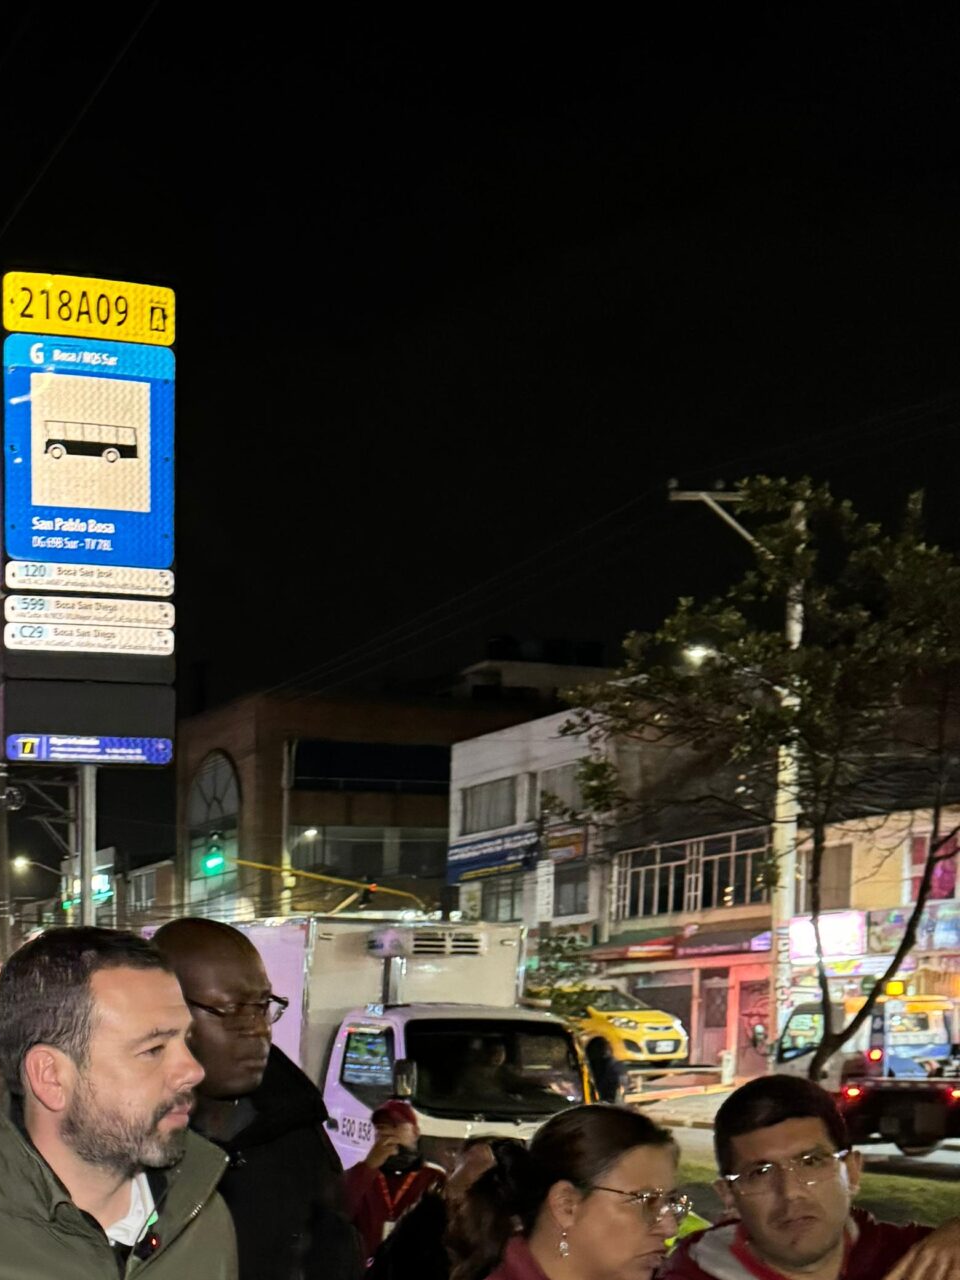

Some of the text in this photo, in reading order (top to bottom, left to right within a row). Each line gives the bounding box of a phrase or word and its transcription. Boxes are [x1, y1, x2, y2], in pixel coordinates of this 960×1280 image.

[20, 286, 128, 327] 218A09
[30, 342, 44, 364] G
[32, 516, 115, 533] San Pablo Bosa
[24, 564, 47, 577] 120
[56, 566, 77, 576] Bosa
[79, 568, 94, 577] San
[21, 597, 45, 611] 599
[55, 600, 76, 610] Bosa
[78, 601, 93, 611] San
[20, 625, 43, 638] C29
[53, 627, 74, 637] Bosa
[76, 628, 91, 638] San
